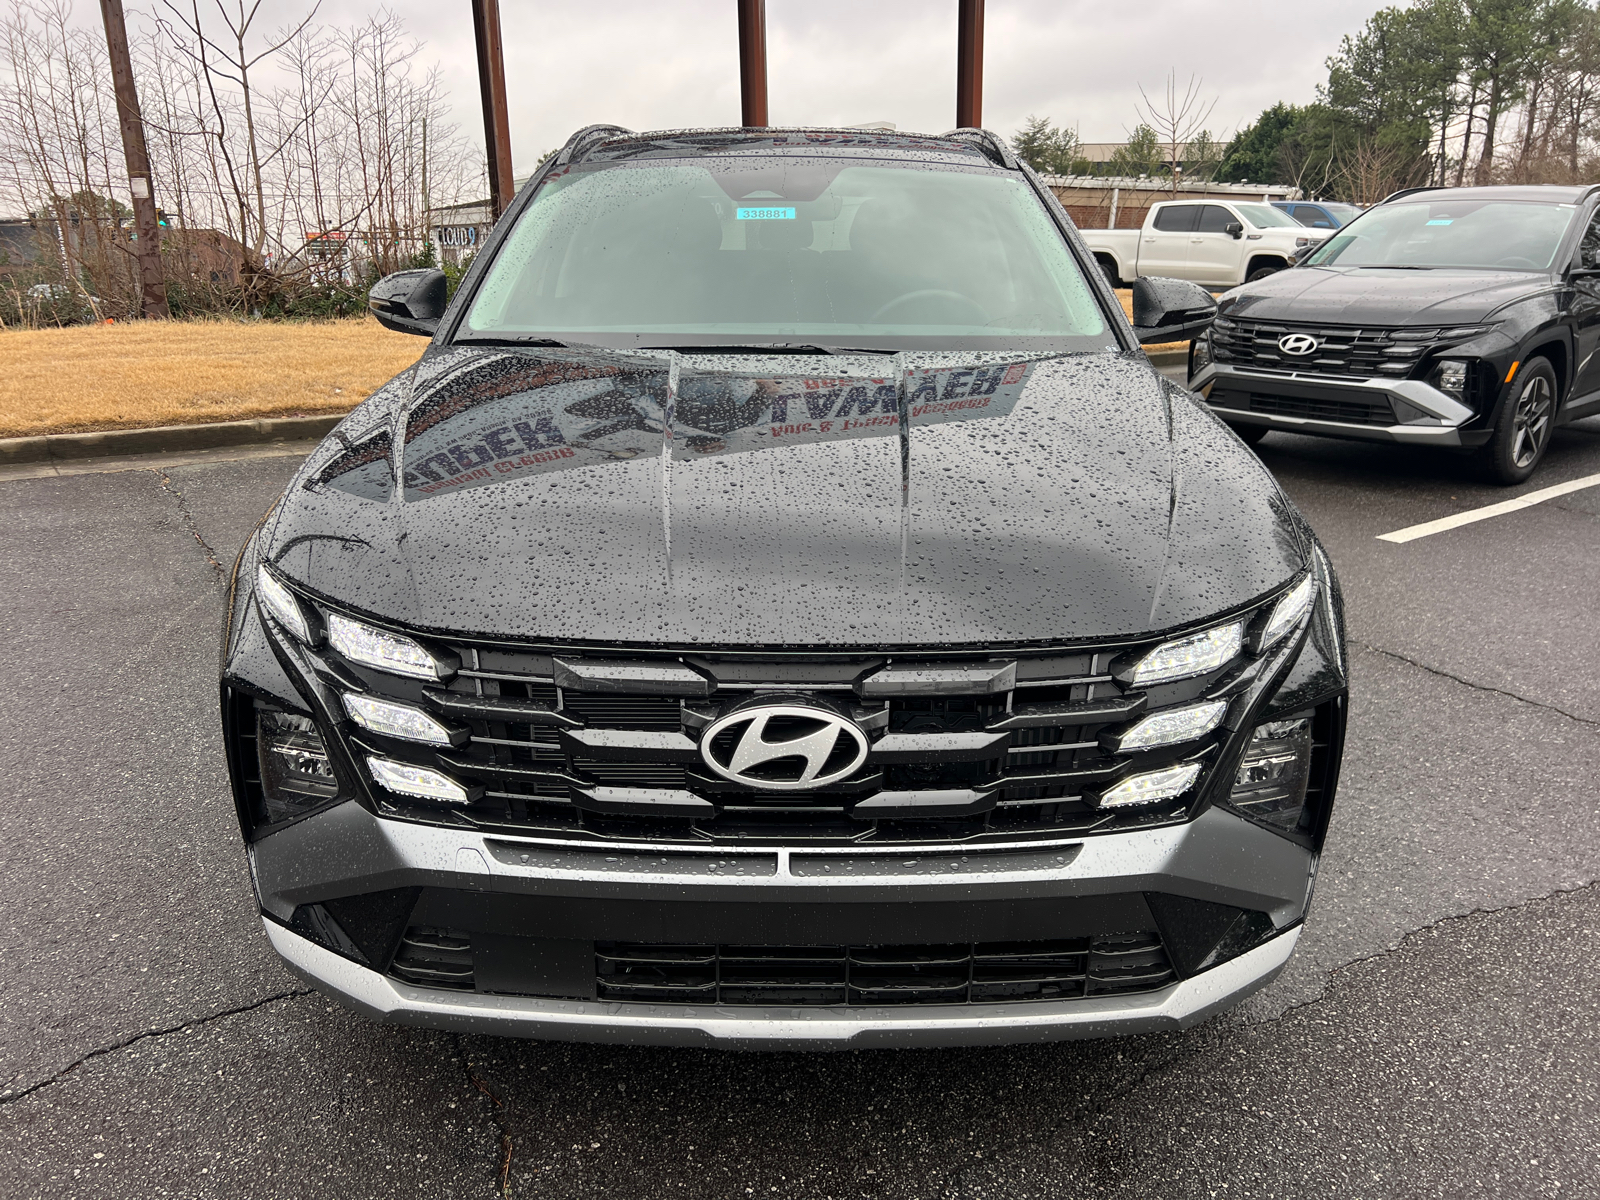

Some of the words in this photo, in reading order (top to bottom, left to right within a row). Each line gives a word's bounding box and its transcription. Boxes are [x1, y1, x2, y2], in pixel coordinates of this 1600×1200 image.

[743, 210, 787, 218] 338881
[437, 227, 468, 246] CLOUD
[468, 227, 476, 246] 9
